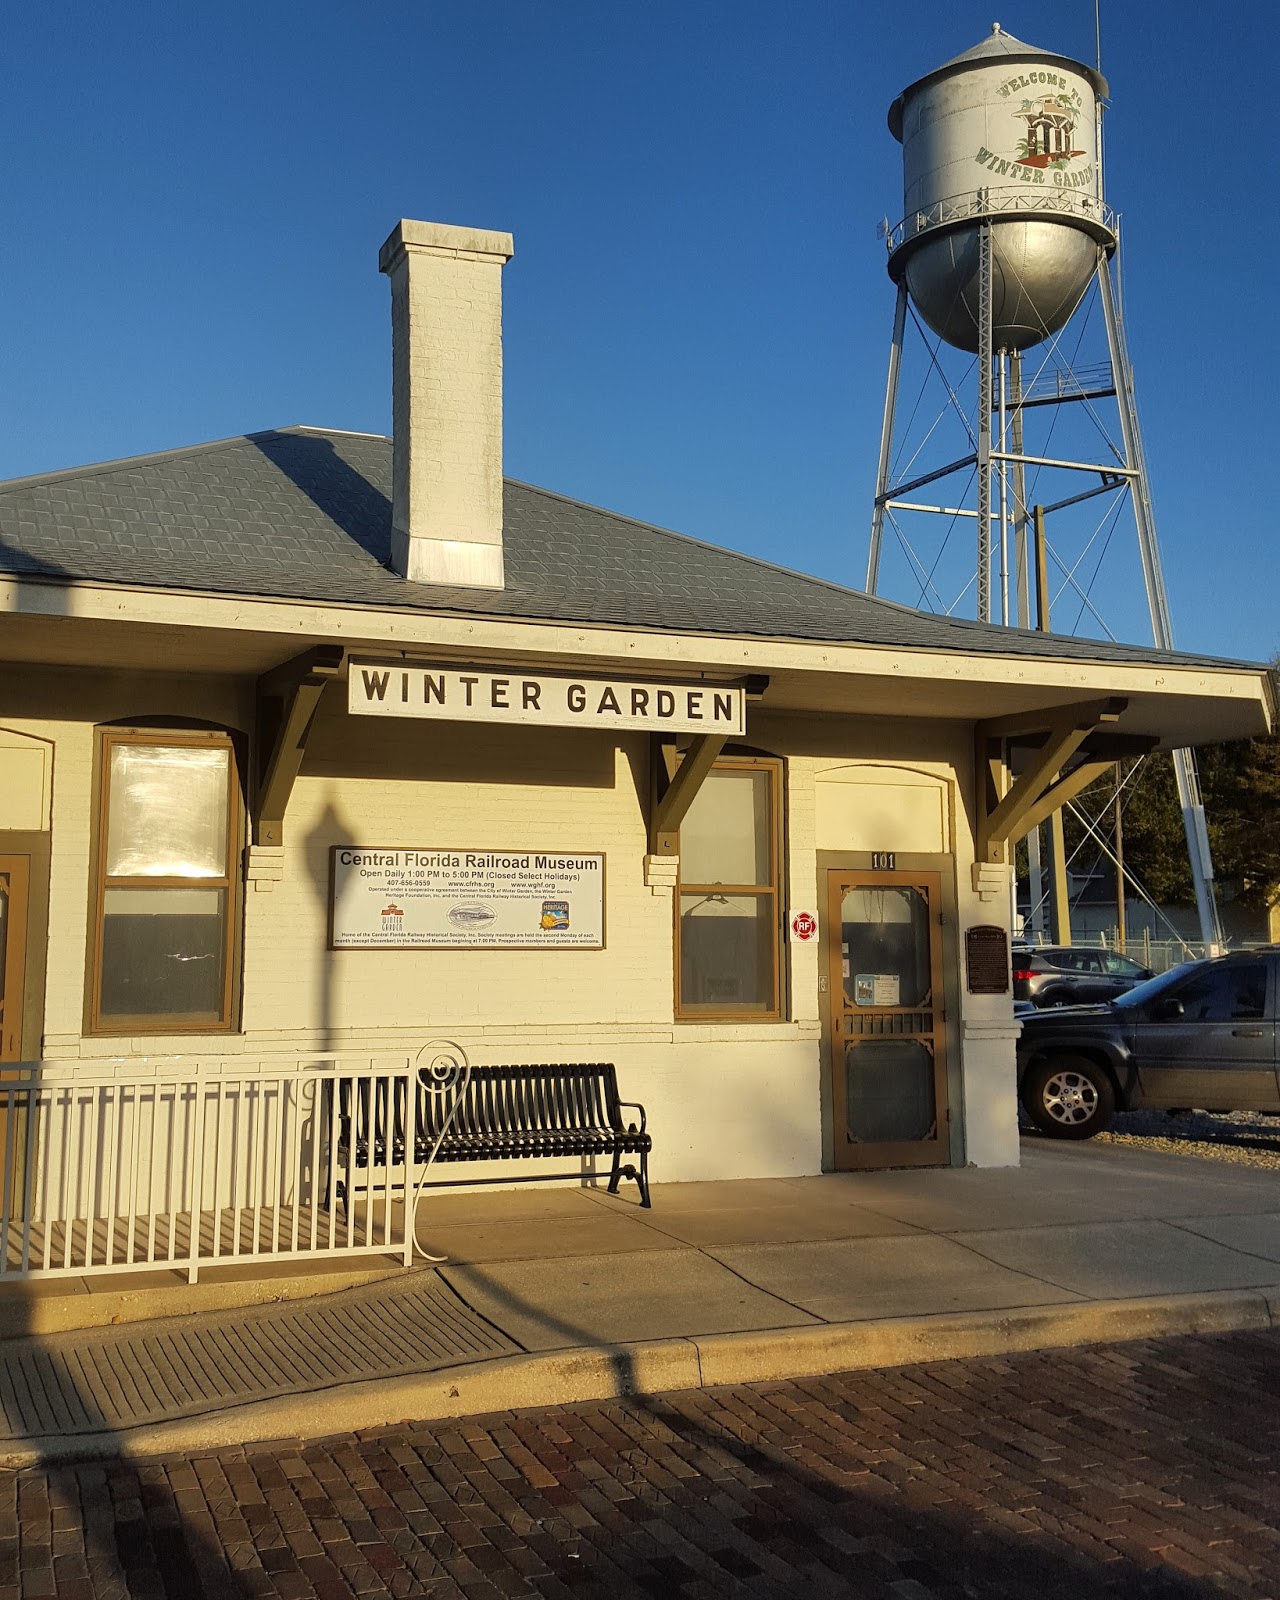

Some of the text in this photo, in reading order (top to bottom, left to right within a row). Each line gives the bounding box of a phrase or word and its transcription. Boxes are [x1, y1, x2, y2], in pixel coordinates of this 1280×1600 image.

[996, 72, 1082, 107] WELCOME TO
[975, 147, 1094, 187] WINTER GARDEN
[361, 670, 732, 721] WINTER GARDEN
[341, 852, 598, 870] Central Florida Railroad Museum
[873, 854, 894, 869] 101
[360, 870, 382, 878] Open
[385, 870, 405, 878] Daily
[544, 873, 580, 882] Holidays)
[798, 921, 810, 931] RF
